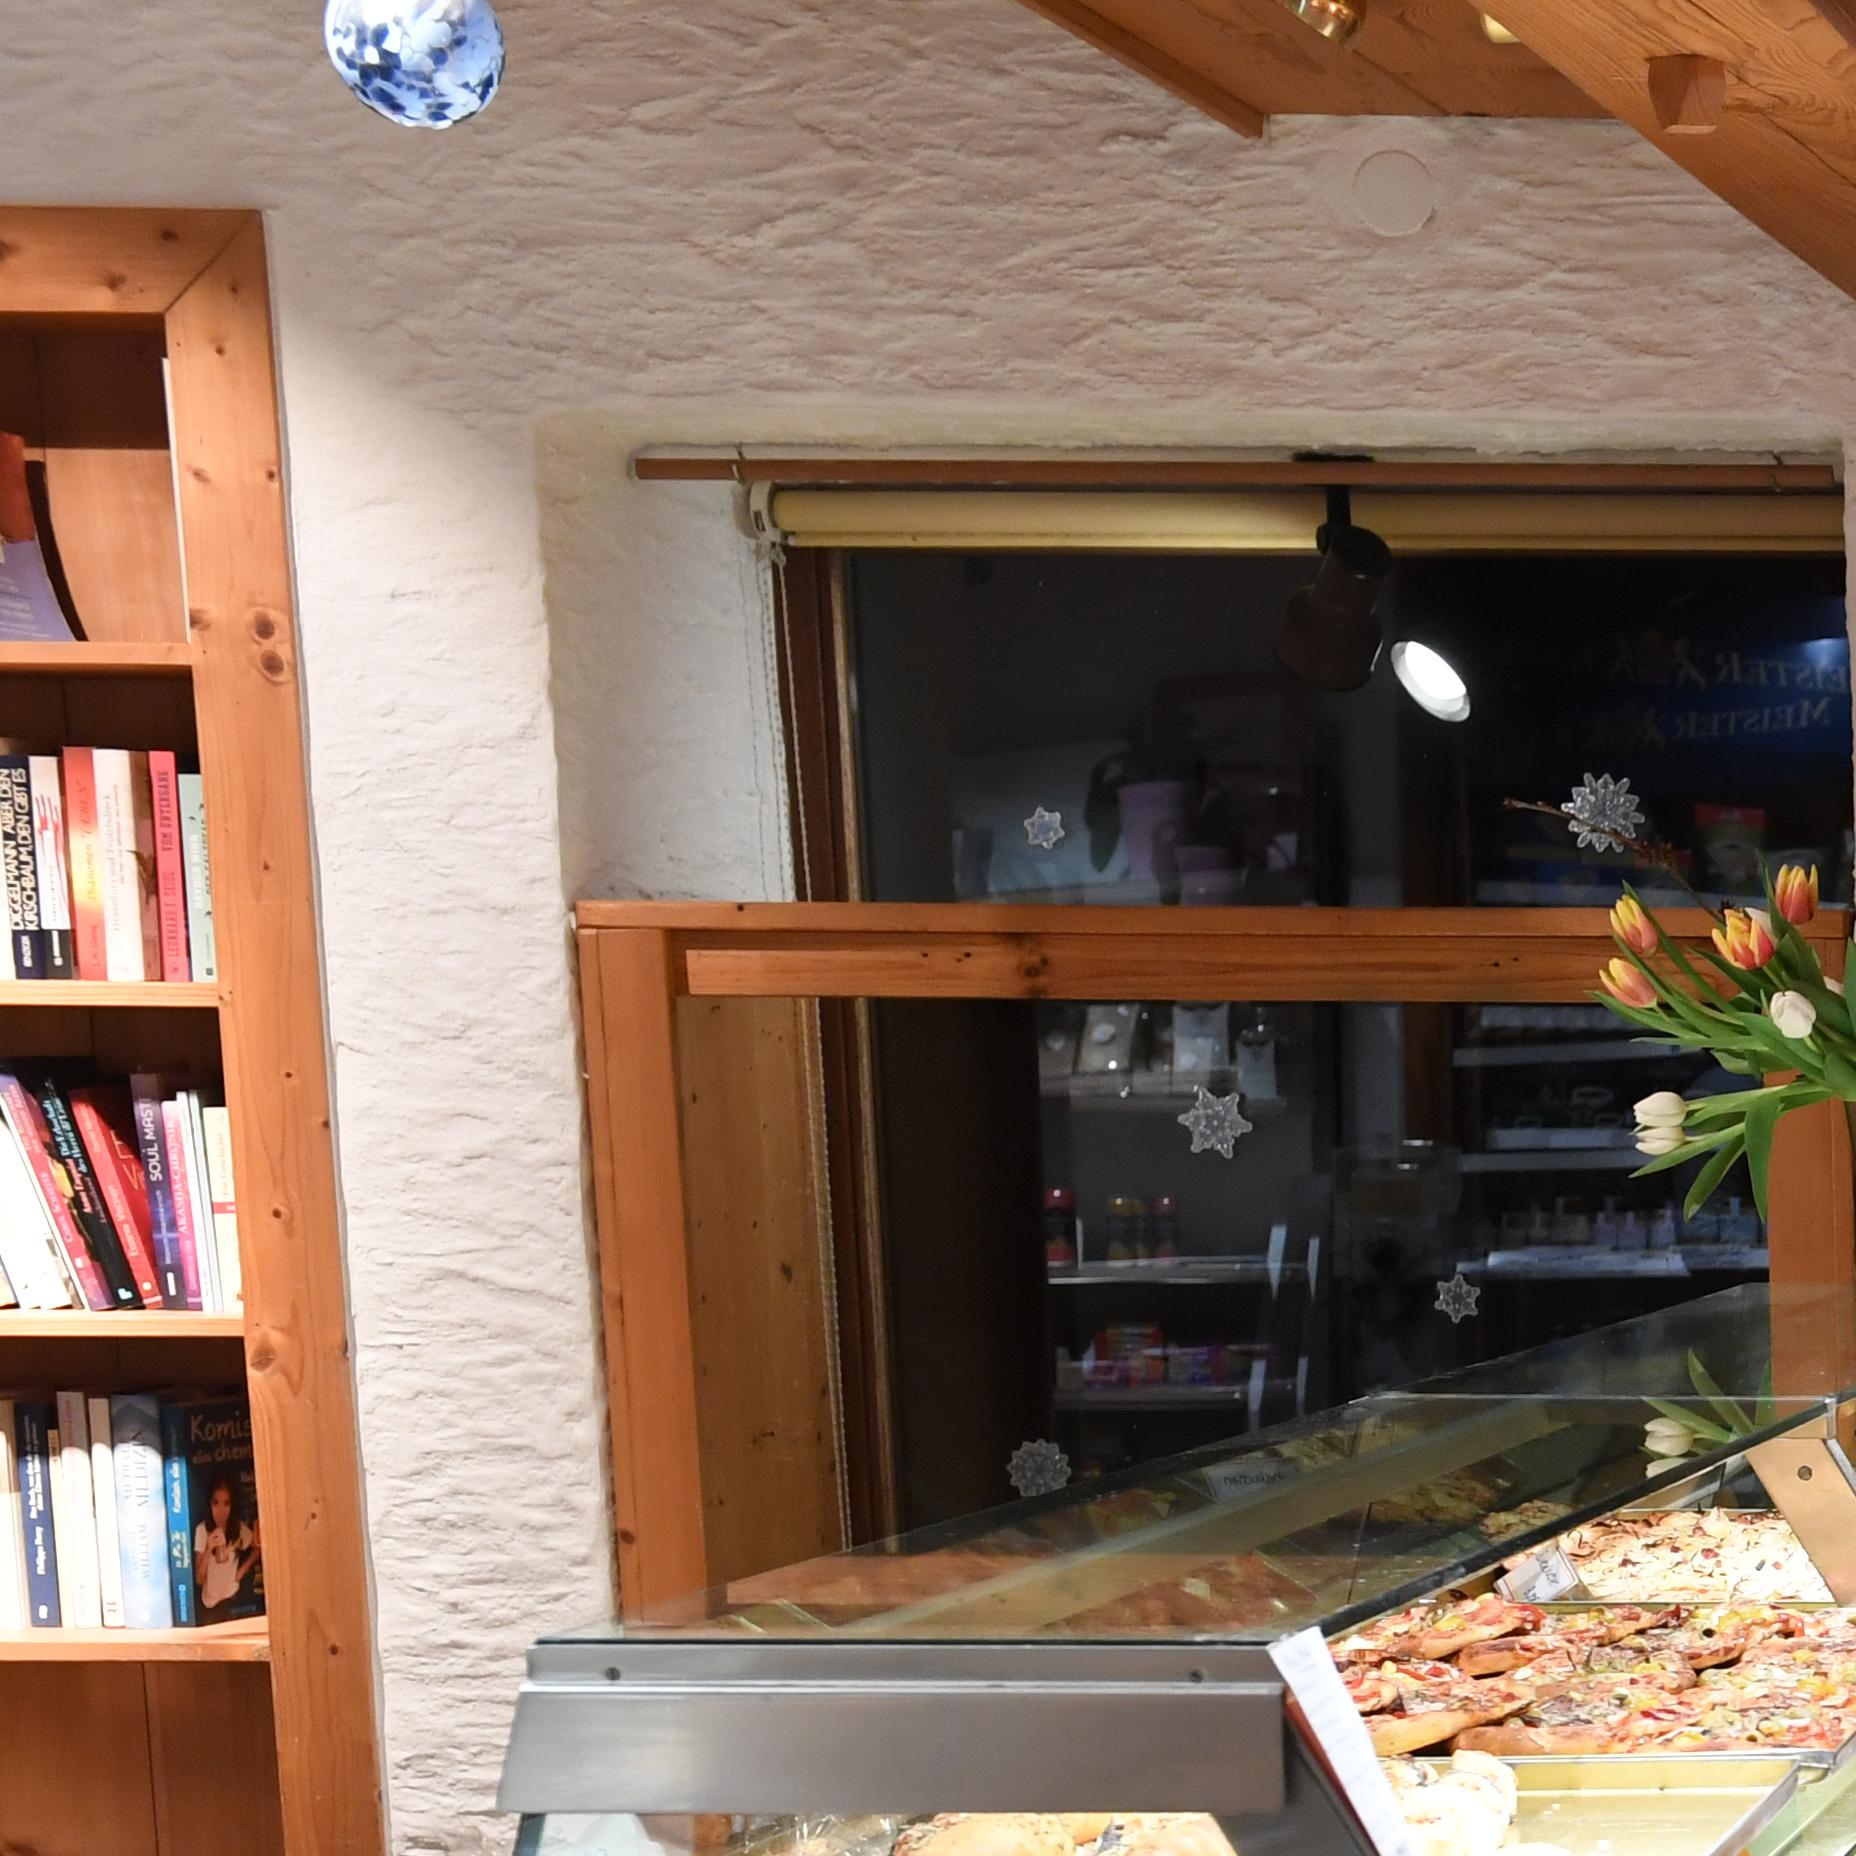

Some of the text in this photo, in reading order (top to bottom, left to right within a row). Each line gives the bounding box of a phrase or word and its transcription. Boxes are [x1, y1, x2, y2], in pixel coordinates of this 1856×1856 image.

[11, 768, 25, 783] ES
[0, 768, 24, 930] DIGGELMANN ABER DEN
[139, 1102, 163, 1182] SOUL MAST
